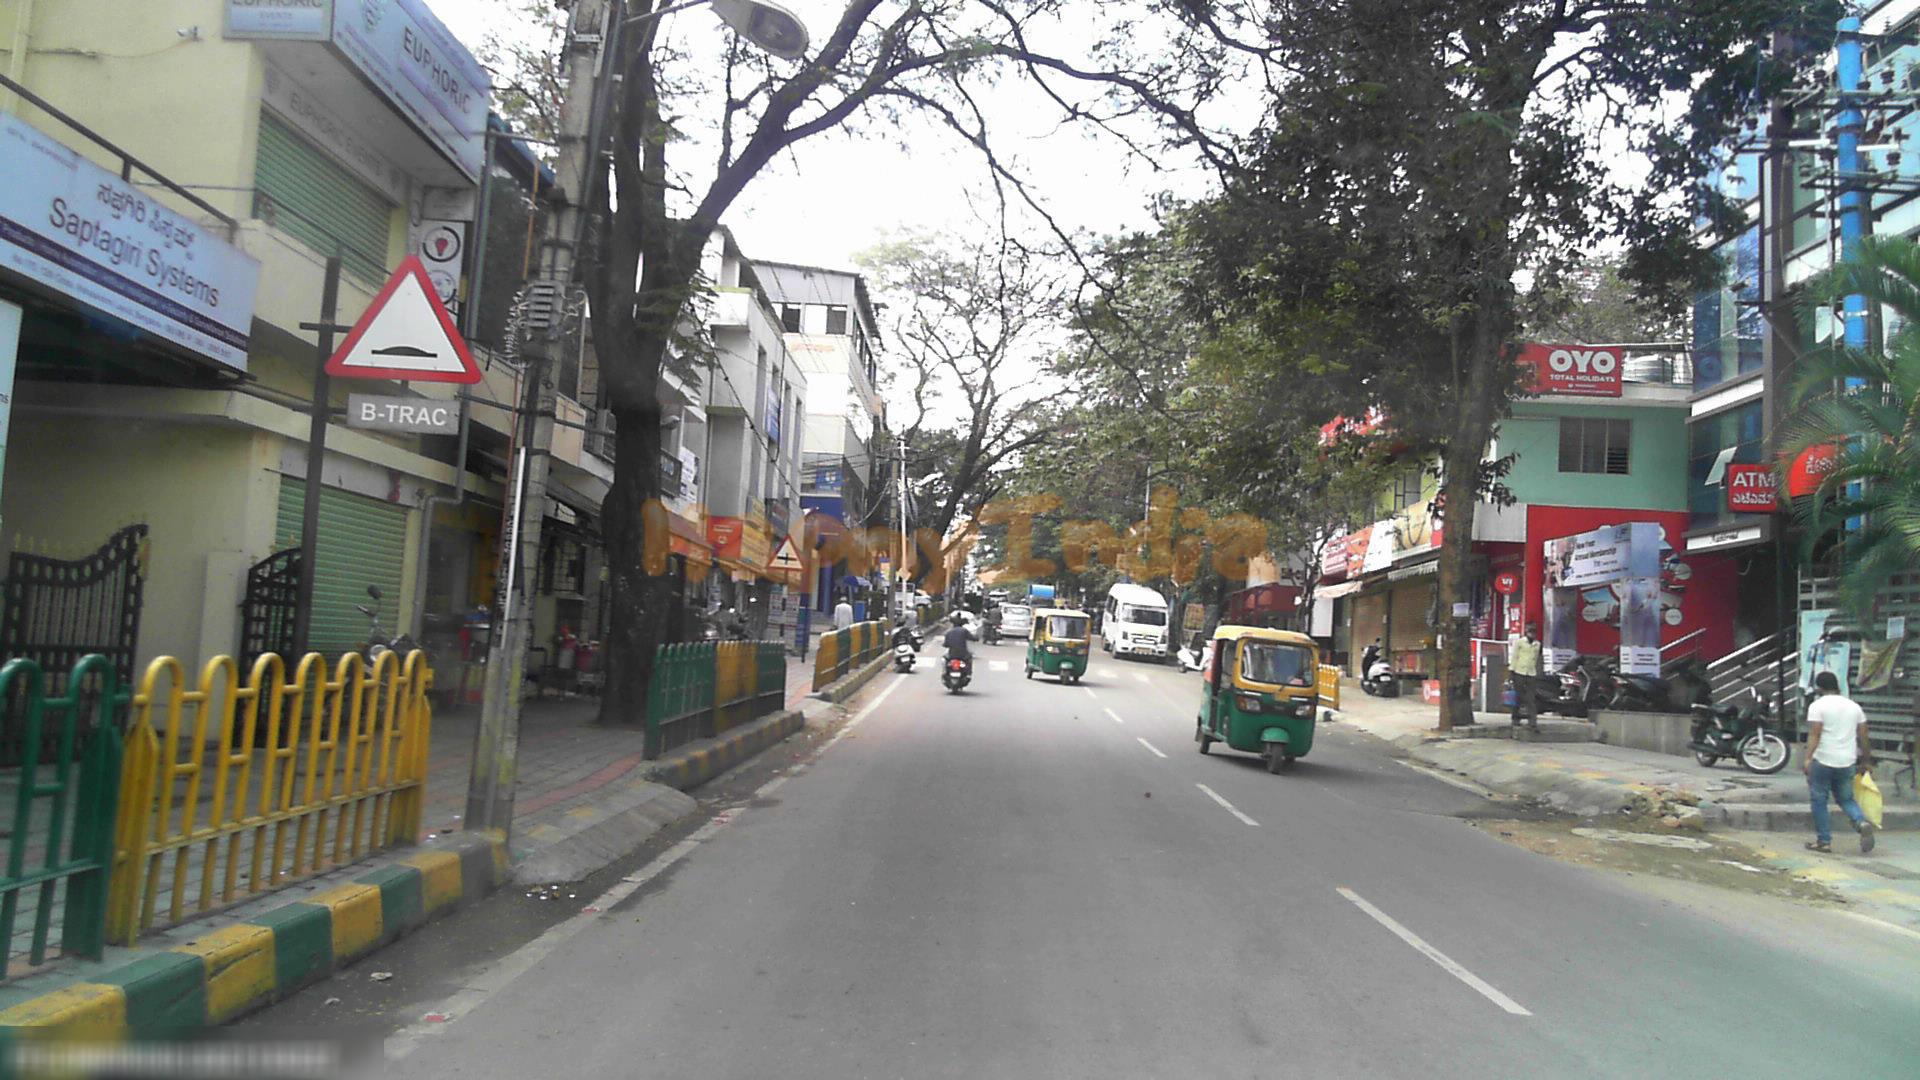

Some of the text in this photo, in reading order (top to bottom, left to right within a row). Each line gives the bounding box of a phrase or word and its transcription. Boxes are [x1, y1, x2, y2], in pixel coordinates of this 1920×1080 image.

[404, 26, 471, 114] EUPHORIC
[50, 198, 143, 267] Saptagiri
[146, 248, 220, 308] Systems
[1549, 349, 1616, 374] OYO
[361, 402, 447, 426] B-TRAC
[1733, 471, 1777, 487] ATM
